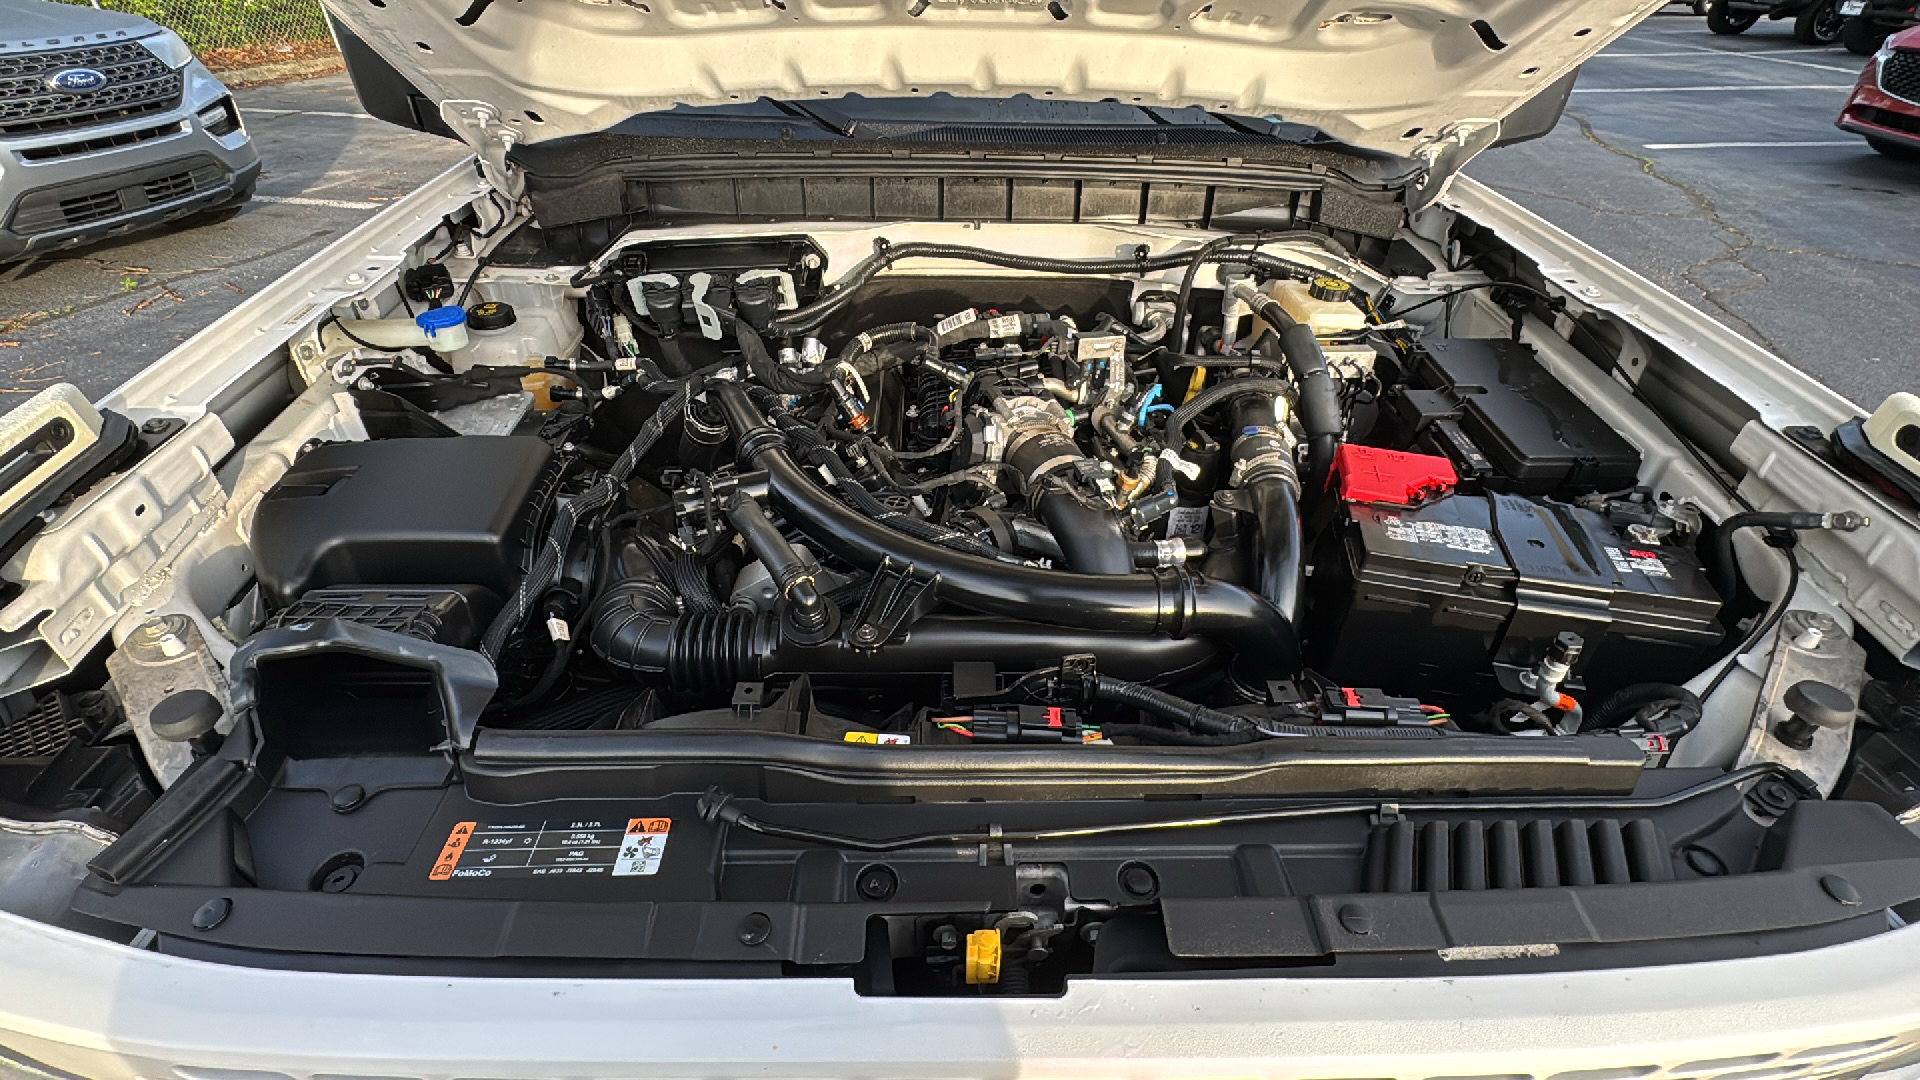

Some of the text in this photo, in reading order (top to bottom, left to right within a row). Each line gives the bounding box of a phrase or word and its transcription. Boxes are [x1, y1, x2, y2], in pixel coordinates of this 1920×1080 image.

[67, 73, 97, 87] Ford
[482, 837, 513, 845] R-1234yf
[587, 833, 596, 841] kg
[452, 868, 492, 877] FoMoCo
